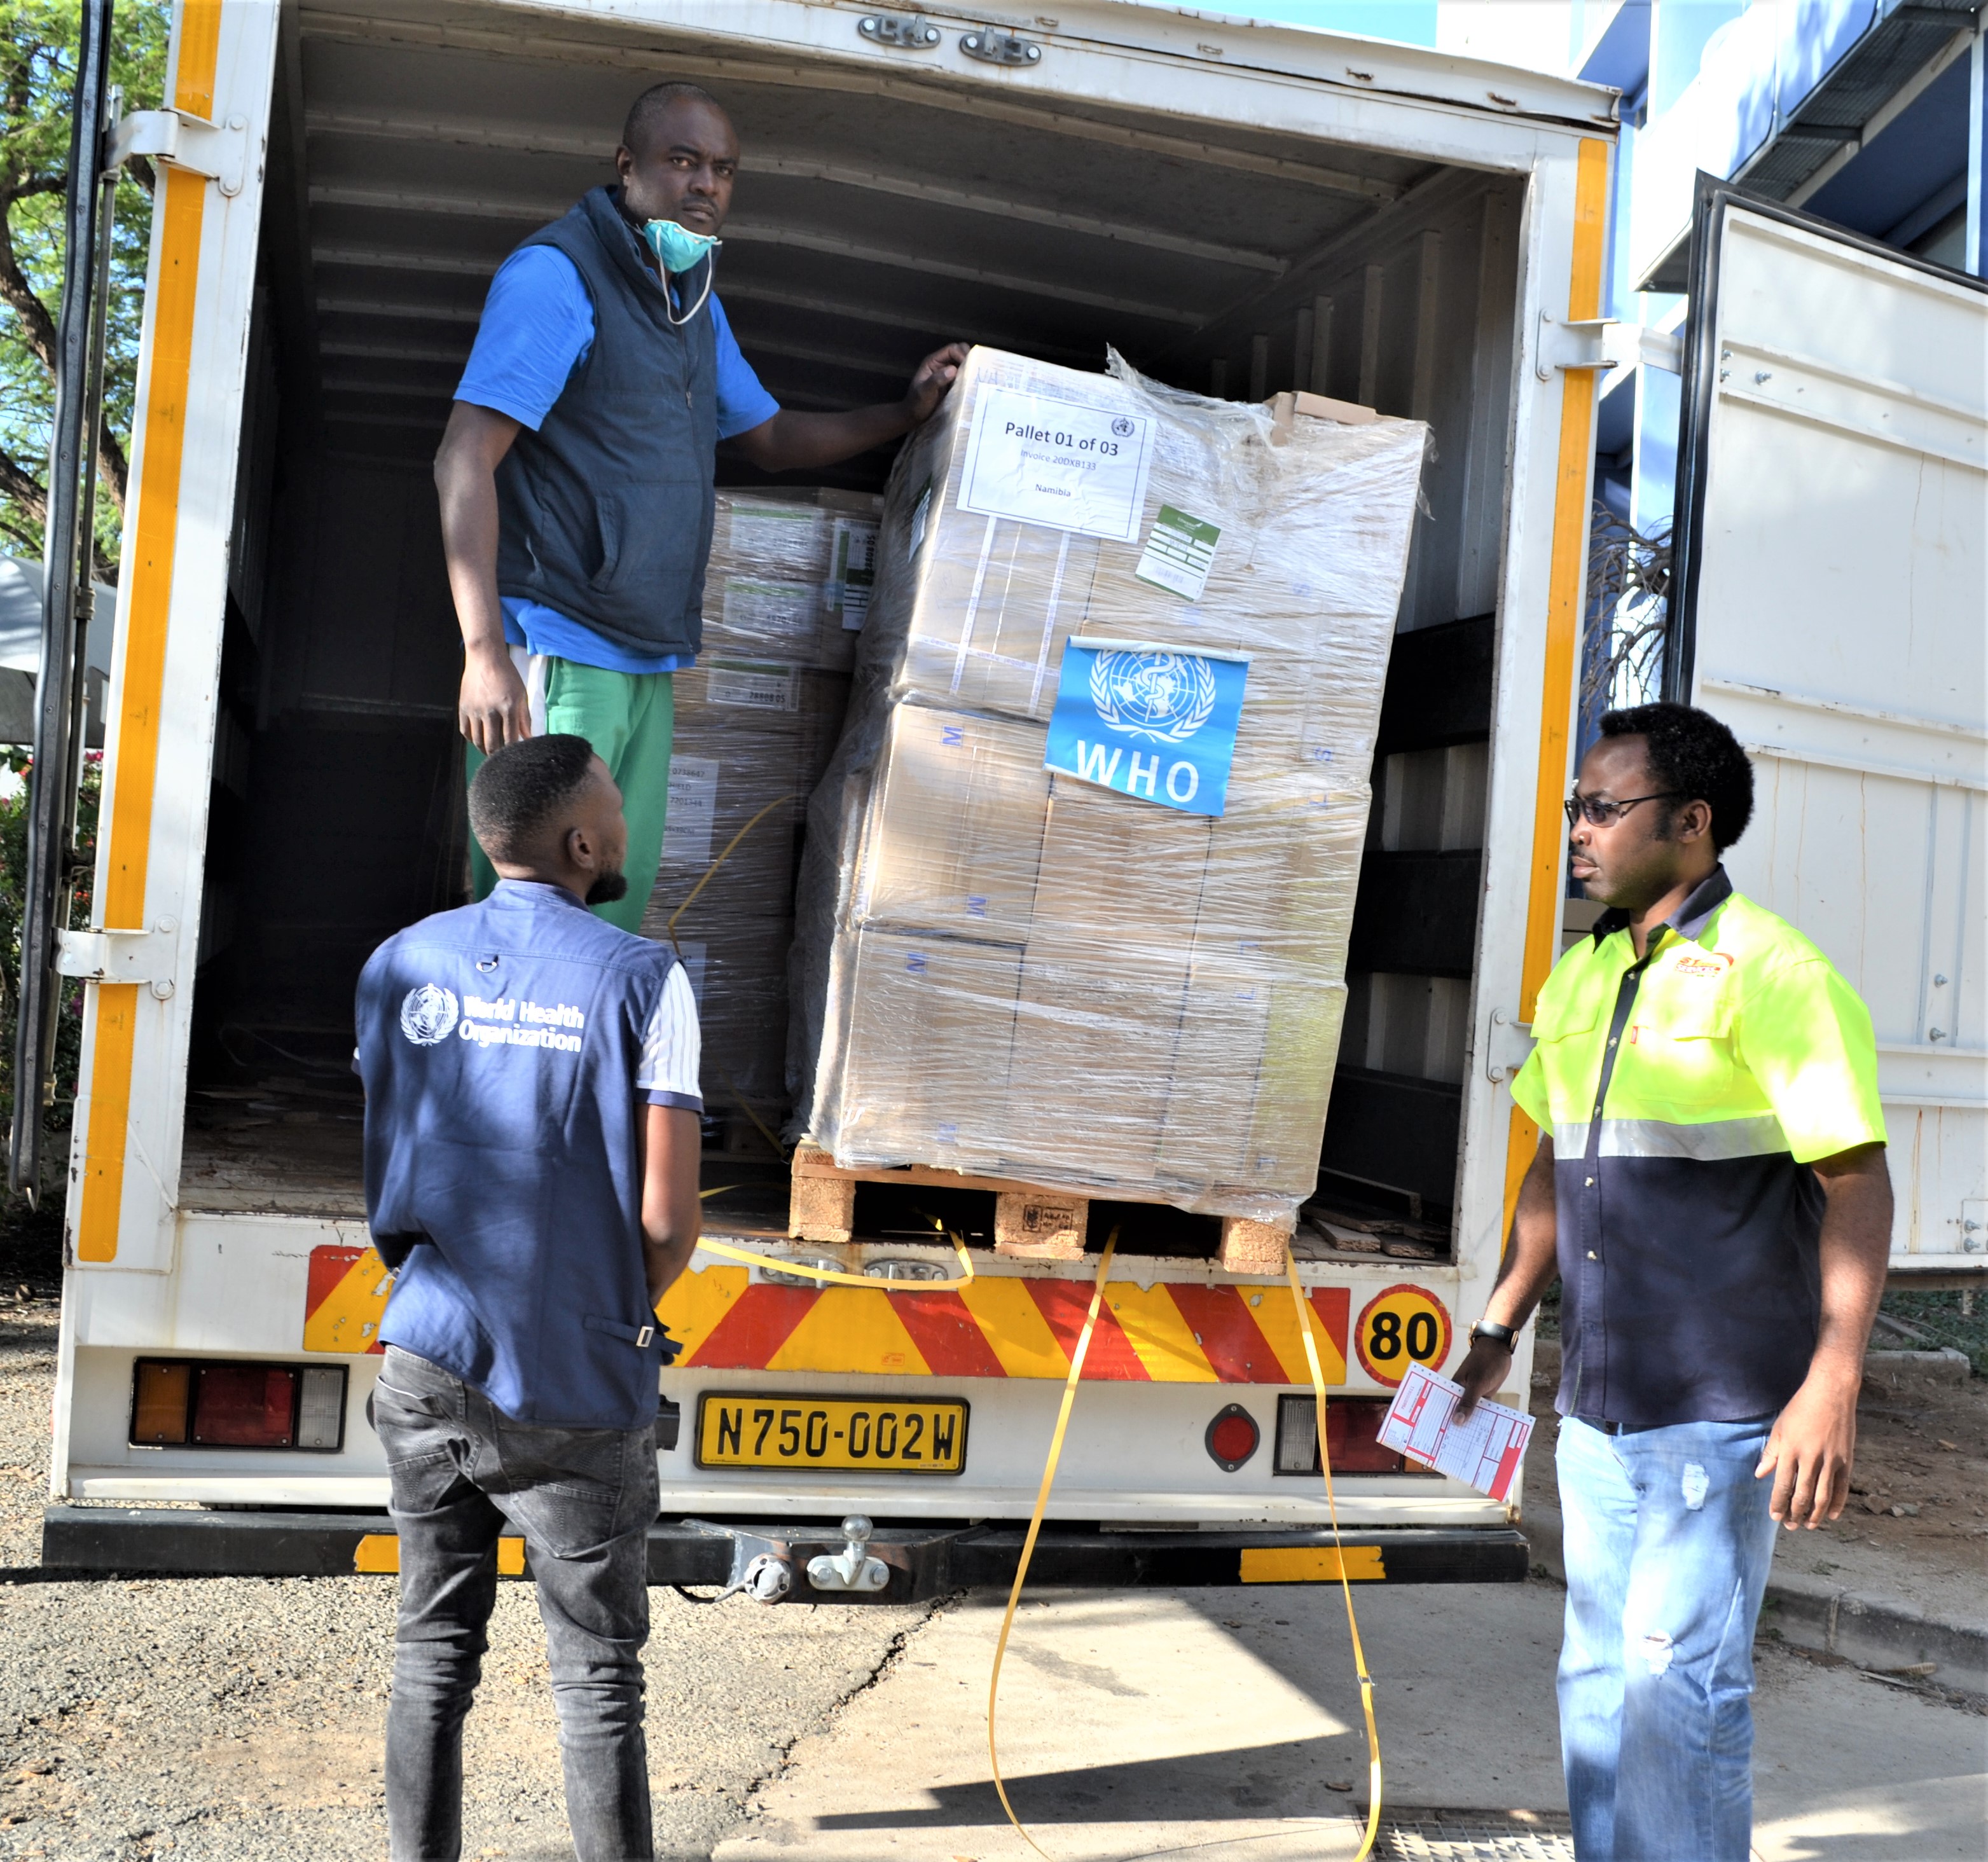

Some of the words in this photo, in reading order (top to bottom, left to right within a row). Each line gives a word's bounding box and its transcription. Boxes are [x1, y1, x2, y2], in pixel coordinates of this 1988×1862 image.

[1005, 422, 1051, 443] Pallet
[1055, 432, 1073, 447] 01
[1079, 438, 1096, 451] of
[1100, 441, 1118, 456] 03
[1020, 449, 1051, 462] Invoice
[1053, 456, 1096, 471] 20DXB133
[1035, 483, 1072, 497] Namibia
[942, 726, 963, 747] M
[1077, 740, 1199, 803] WHO
[463, 995, 516, 1021] World
[519, 1000, 585, 1029] Health
[458, 1019, 583, 1052] Organization
[1370, 1312, 1438, 1360] 80
